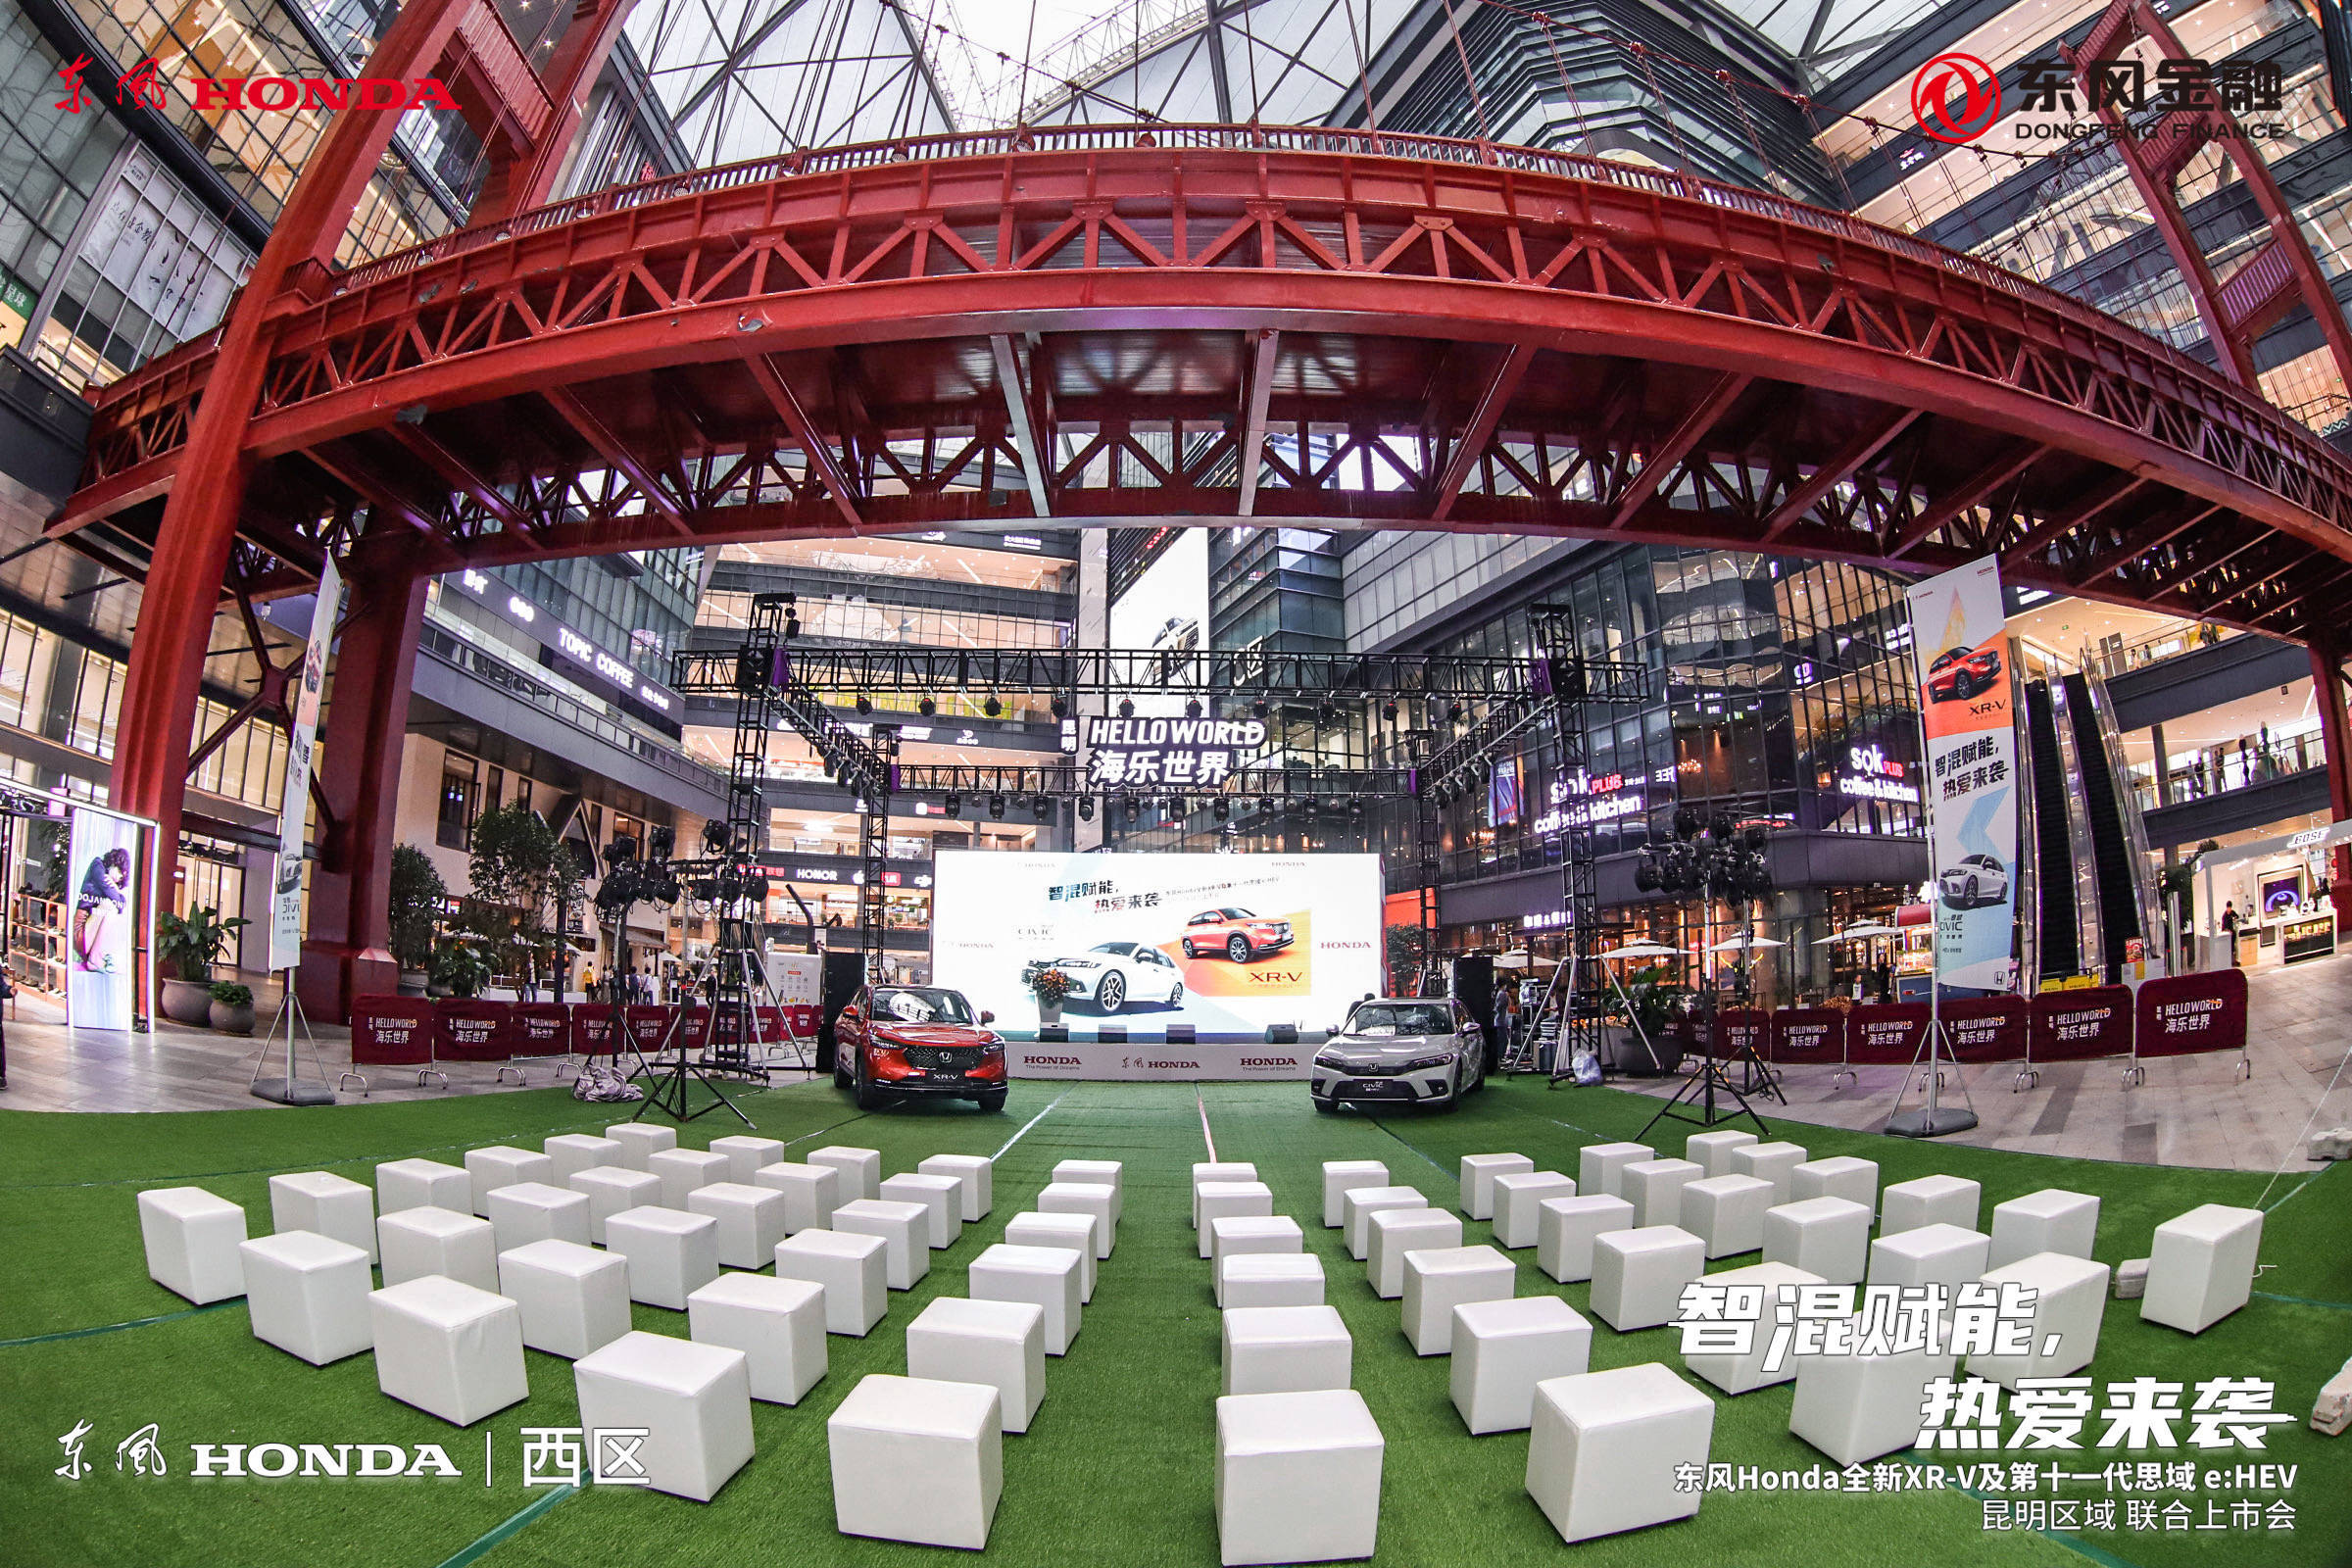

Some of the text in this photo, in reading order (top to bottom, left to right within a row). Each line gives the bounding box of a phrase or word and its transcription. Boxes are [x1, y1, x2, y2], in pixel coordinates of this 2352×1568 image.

[559, 628, 634, 689] TOPIC COFFEE
[1969, 699, 2006, 716] XR-V
[1061, 719, 1077, 752] 昆明
[1090, 749, 1230, 785] 海乐世界
[1591, 774, 1623, 795] PLUS
[1942, 760, 2010, 802] 热爱来袭
[796, 869, 838, 881] HONOR
[1095, 893, 1161, 914] 热爱来袭
[1320, 941, 1372, 950] HONDA
[1250, 971, 1303, 983] XR-V
[2057, 1022, 2100, 1041] 海乐世界
[2165, 1013, 2211, 1034] 海乐世界
[375, 1030, 409, 1045] 海乐世界
[1868, 1032, 1903, 1046] 海乐世界
[1957, 1029, 1995, 1045] 海乐世界
[1023, 1055, 1082, 1065] HONDA
[1148, 1060, 1200, 1069] HONDA
[1240, 1057, 1298, 1066] HONDA
